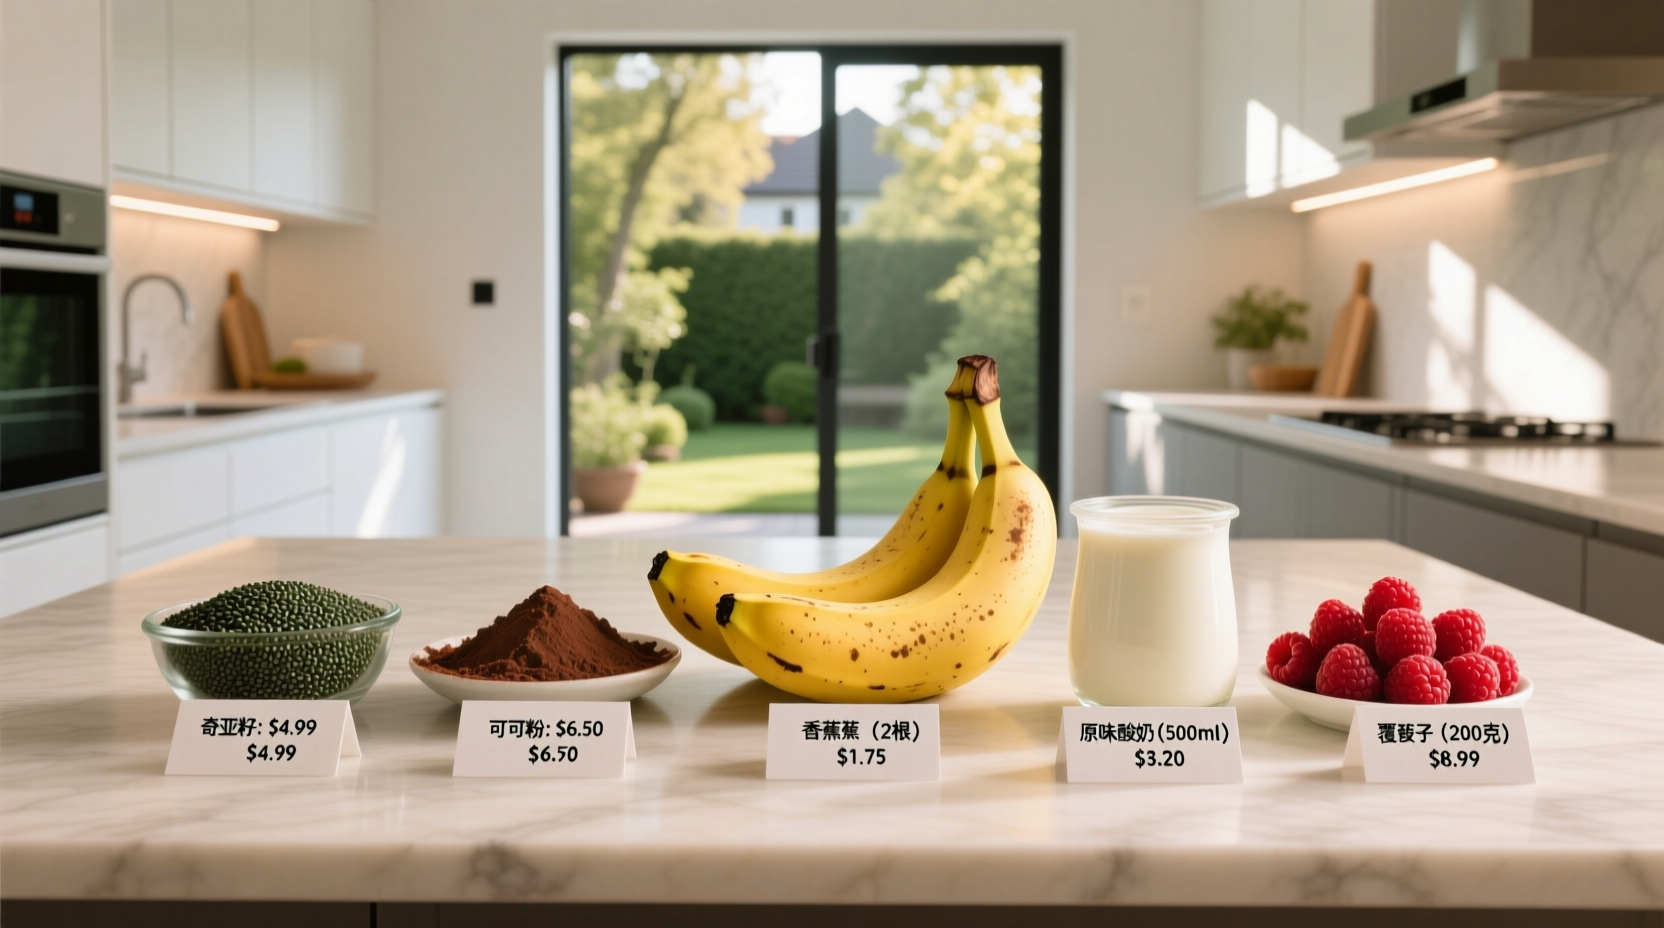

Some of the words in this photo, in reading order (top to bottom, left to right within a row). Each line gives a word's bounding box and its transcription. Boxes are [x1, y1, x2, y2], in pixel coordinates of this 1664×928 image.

[268, 718, 317, 737] $4.99
[489, 718, 551, 739] 可可粉:
[555, 719, 604, 738] $6.50
[246, 743, 297, 763] $4.99
[528, 744, 579, 765] $6.50
[837, 747, 886, 767] $1.75
[1134, 748, 1185, 769] $3.20
[1428, 749, 1480, 769] $8.99
